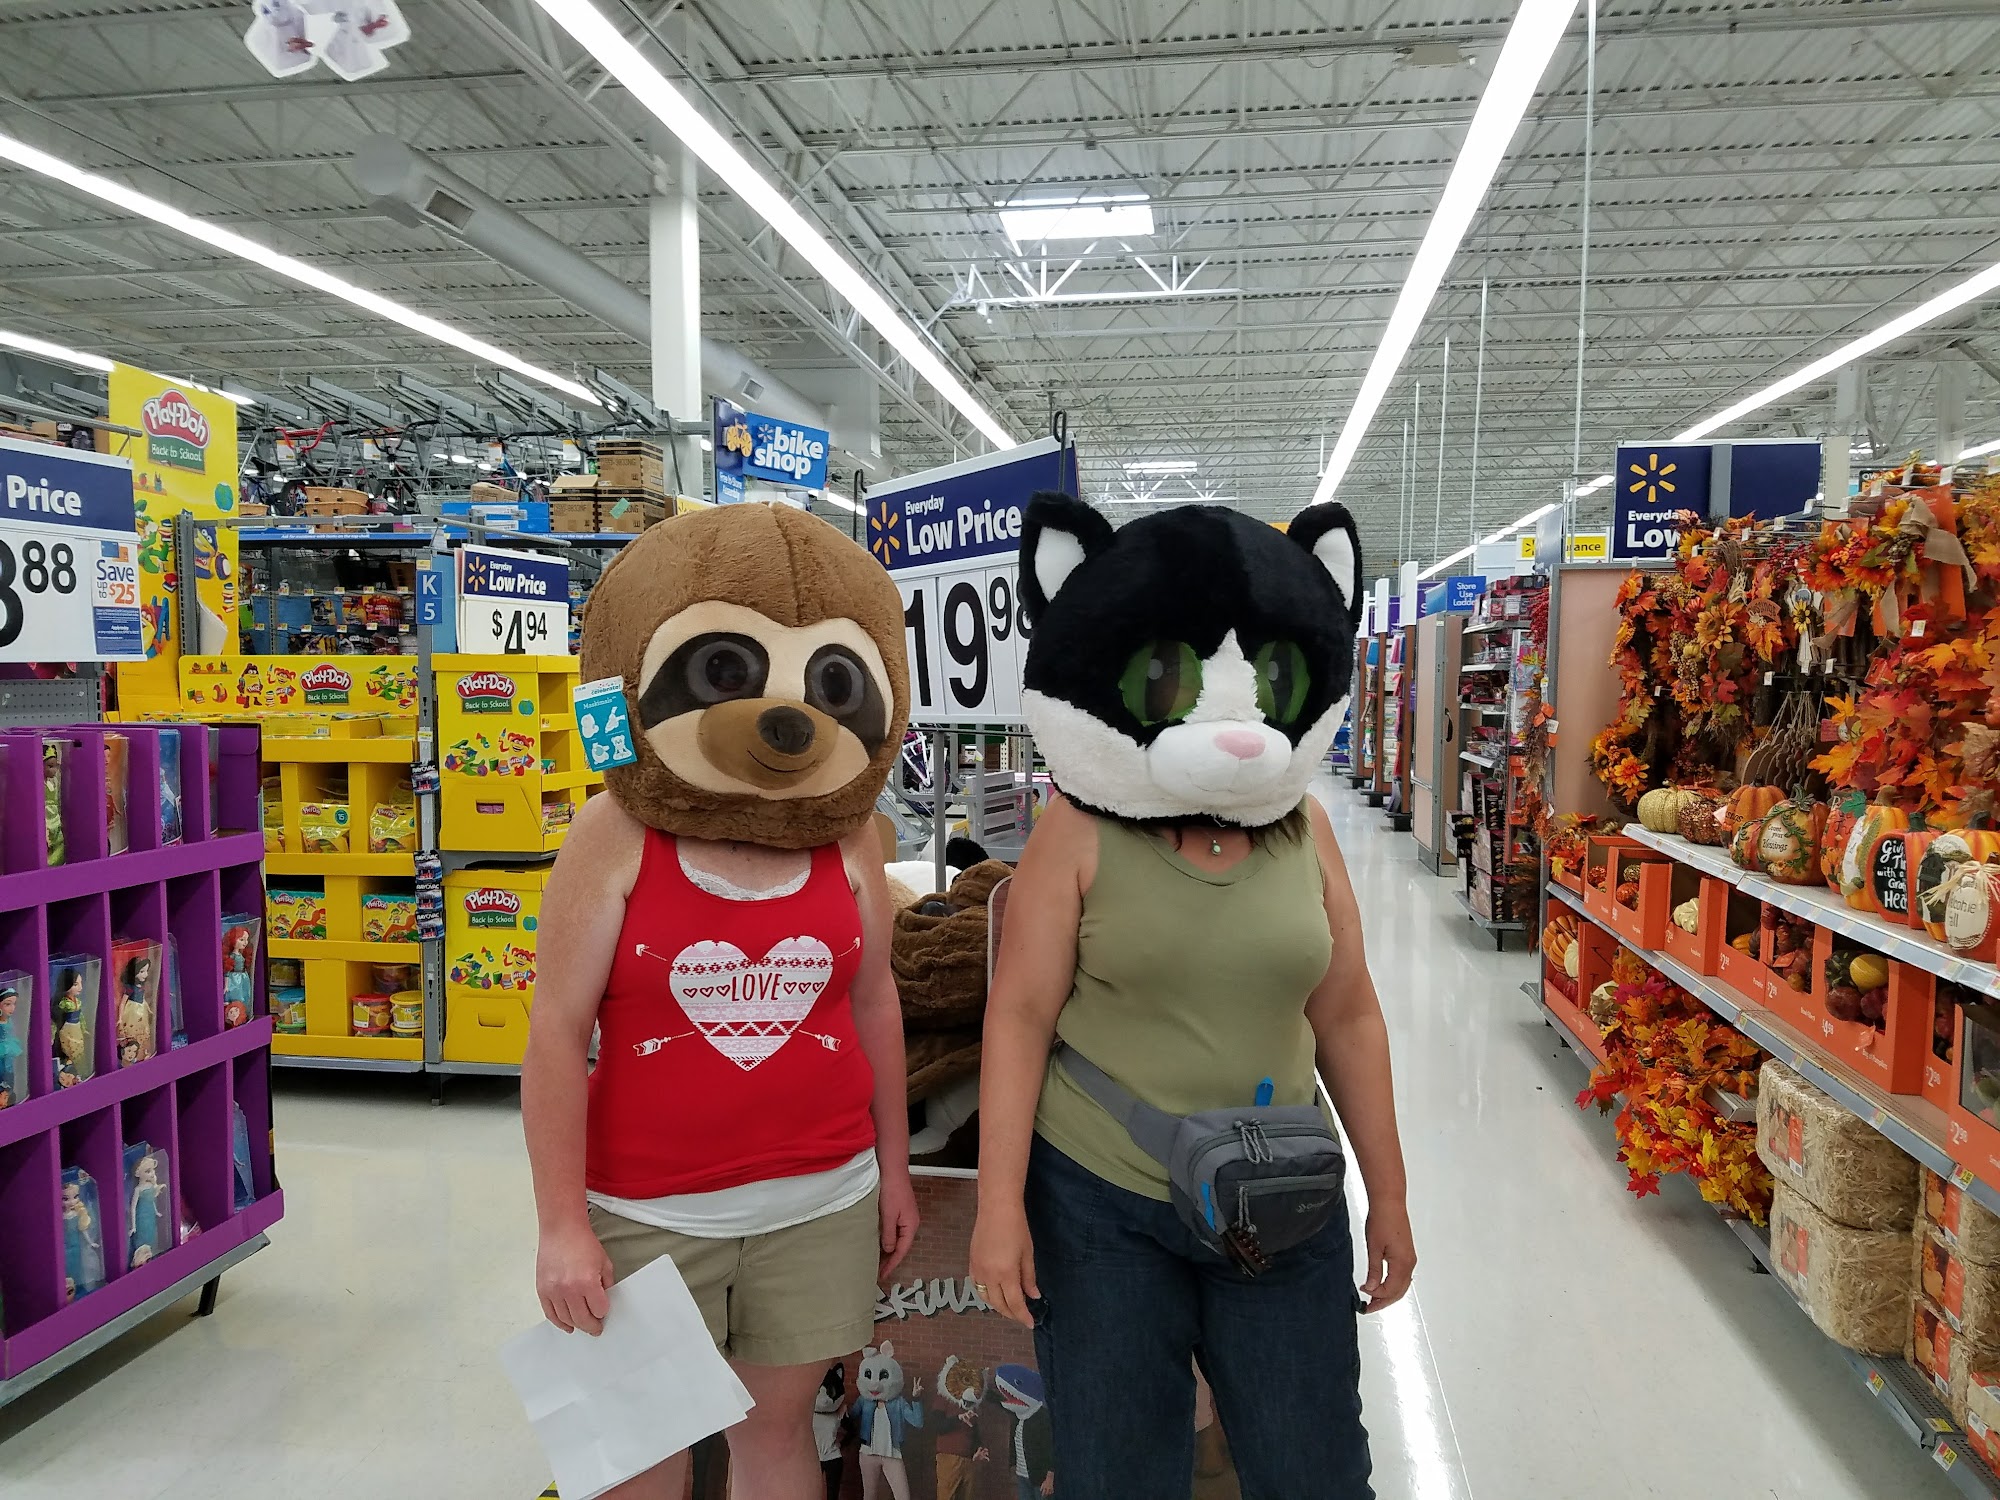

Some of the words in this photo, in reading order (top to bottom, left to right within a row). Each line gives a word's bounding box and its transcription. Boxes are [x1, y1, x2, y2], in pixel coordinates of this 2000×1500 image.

[144, 398, 206, 442] Play-Doh
[151, 443, 169, 457] Back
[170, 445, 177, 458] to
[180, 448, 202, 462] School
[774, 426, 823, 459] bike
[754, 443, 811, 480] shop
[6, 474, 82, 517] Price
[905, 495, 944, 516] Everyday
[1628, 509, 1679, 523] Everyda
[906, 518, 953, 556] Low
[957, 499, 1022, 547] Price
[96, 559, 135, 583] Save
[489, 561, 512, 573] Everyday
[97, 581, 108, 591] up
[422, 574, 438, 595] K
[489, 570, 516, 592] Low
[517, 573, 547, 595] Price
[1456, 582, 1476, 590] Store
[98, 591, 107, 599] to
[109, 583, 135, 605] $25
[423, 602, 437, 621] 5
[301, 669, 350, 688] Play-Doh
[459, 674, 513, 695] Play-Doh
[307, 693, 320, 702] Back
[321, 692, 328, 700] to
[329, 691, 347, 700] School
[465, 702, 480, 710] Back
[481, 701, 488, 709] to
[490, 700, 509, 709] School
[1877, 866, 1896, 878] with
[466, 890, 518, 911] Play-Doh
[472, 916, 486, 924] Back
[487, 915, 494, 923] to
[495, 915, 514, 923] School
[732, 972, 783, 1002] LOVE
